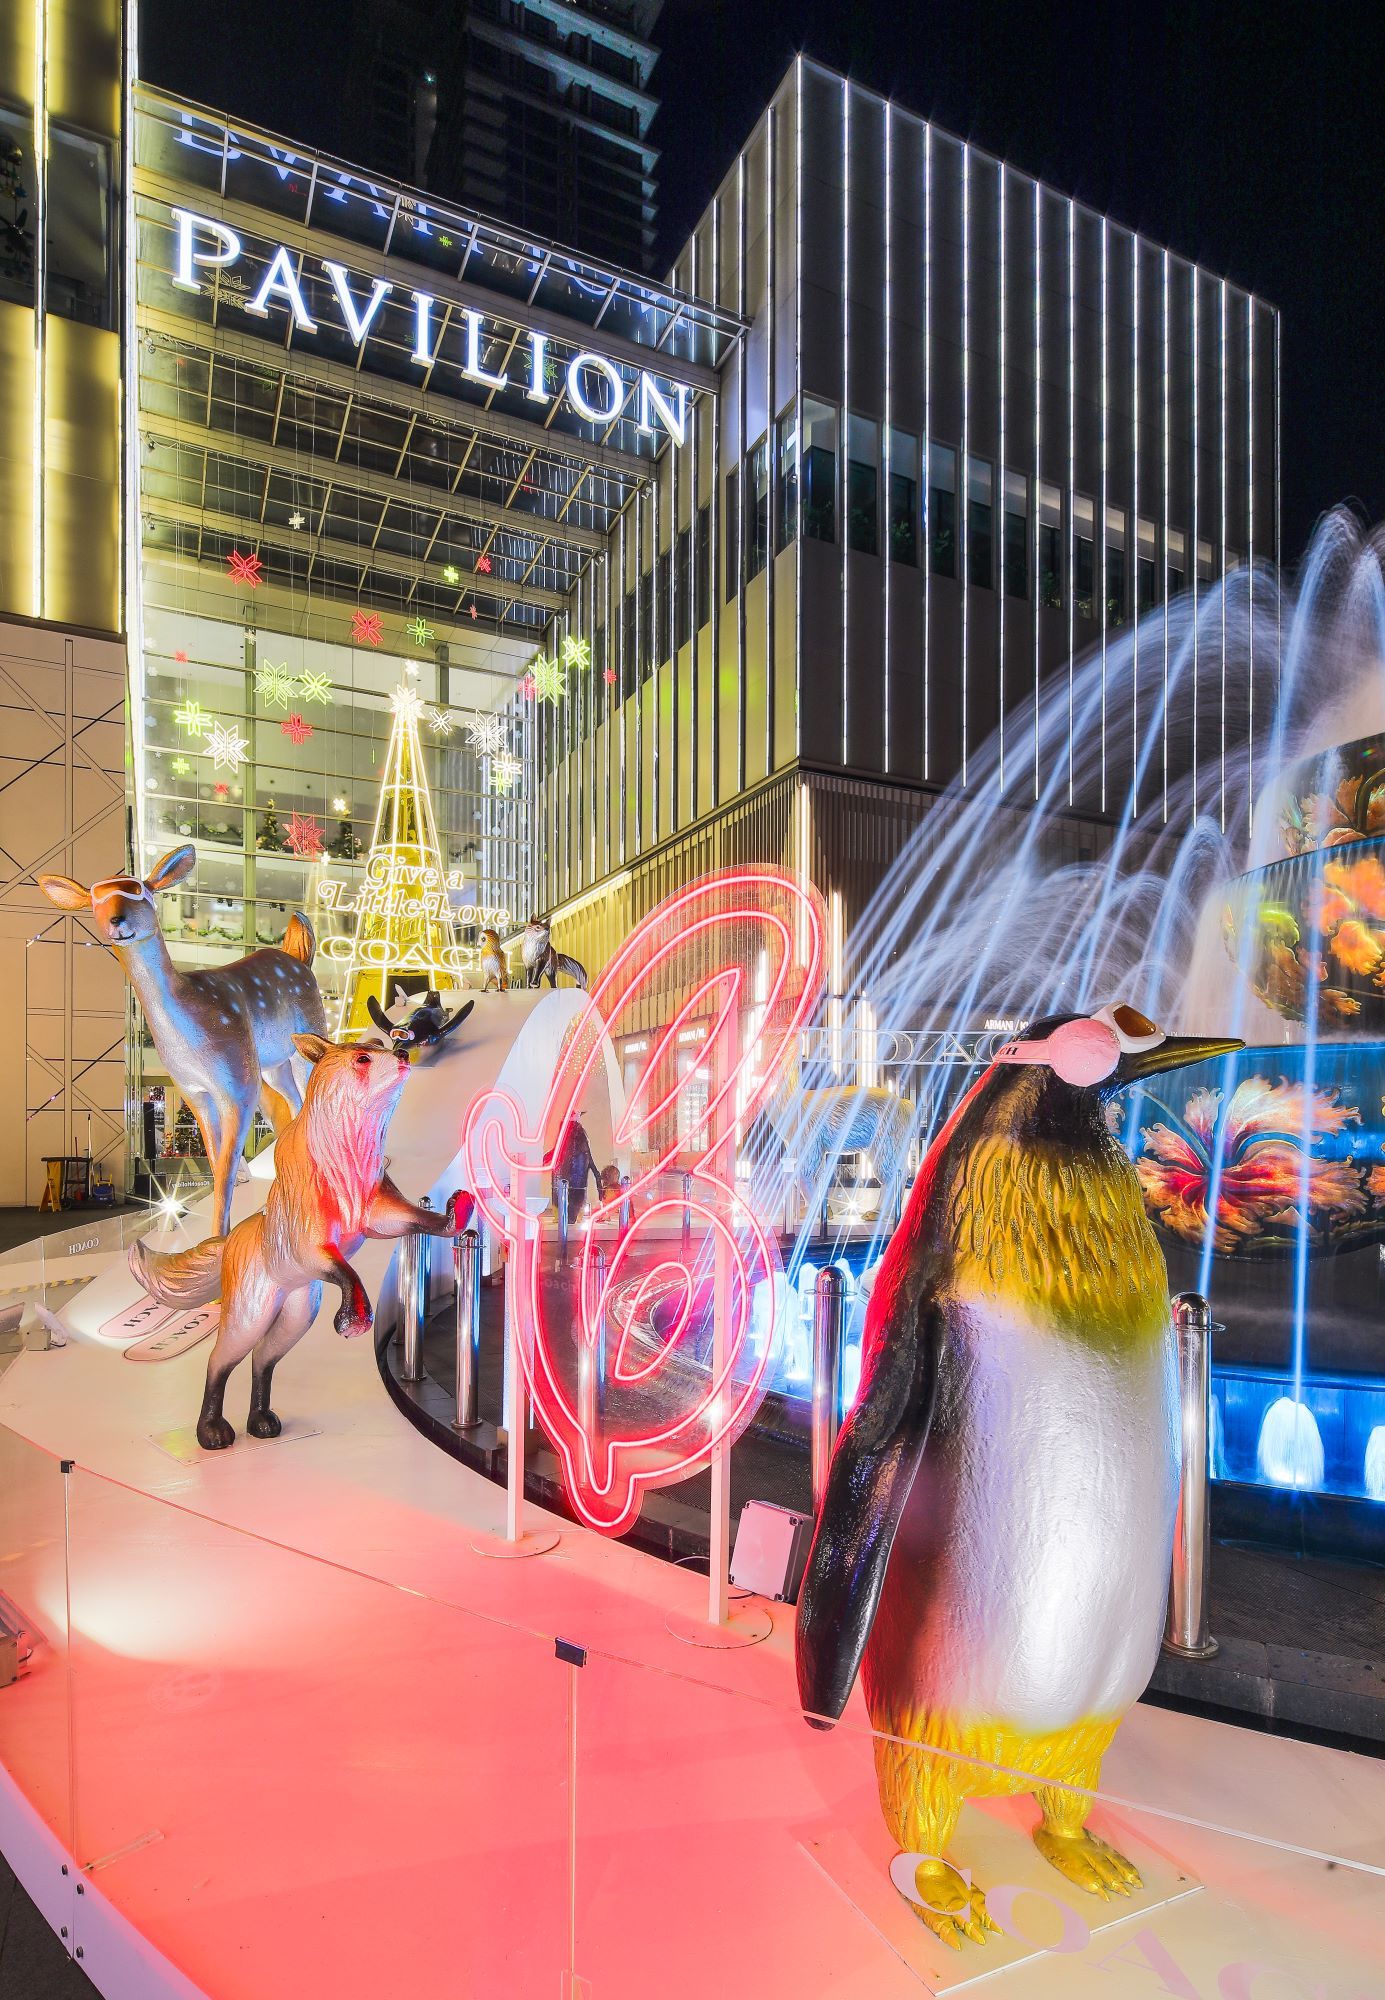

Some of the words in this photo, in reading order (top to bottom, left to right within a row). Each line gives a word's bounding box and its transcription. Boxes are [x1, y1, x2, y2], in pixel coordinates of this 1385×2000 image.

[172, 206, 690, 448] PAVILION
[366, 853, 438, 889] Give
[447, 870, 463, 890] a
[317, 879, 425, 918] Little
[423, 892, 511, 927] Love
